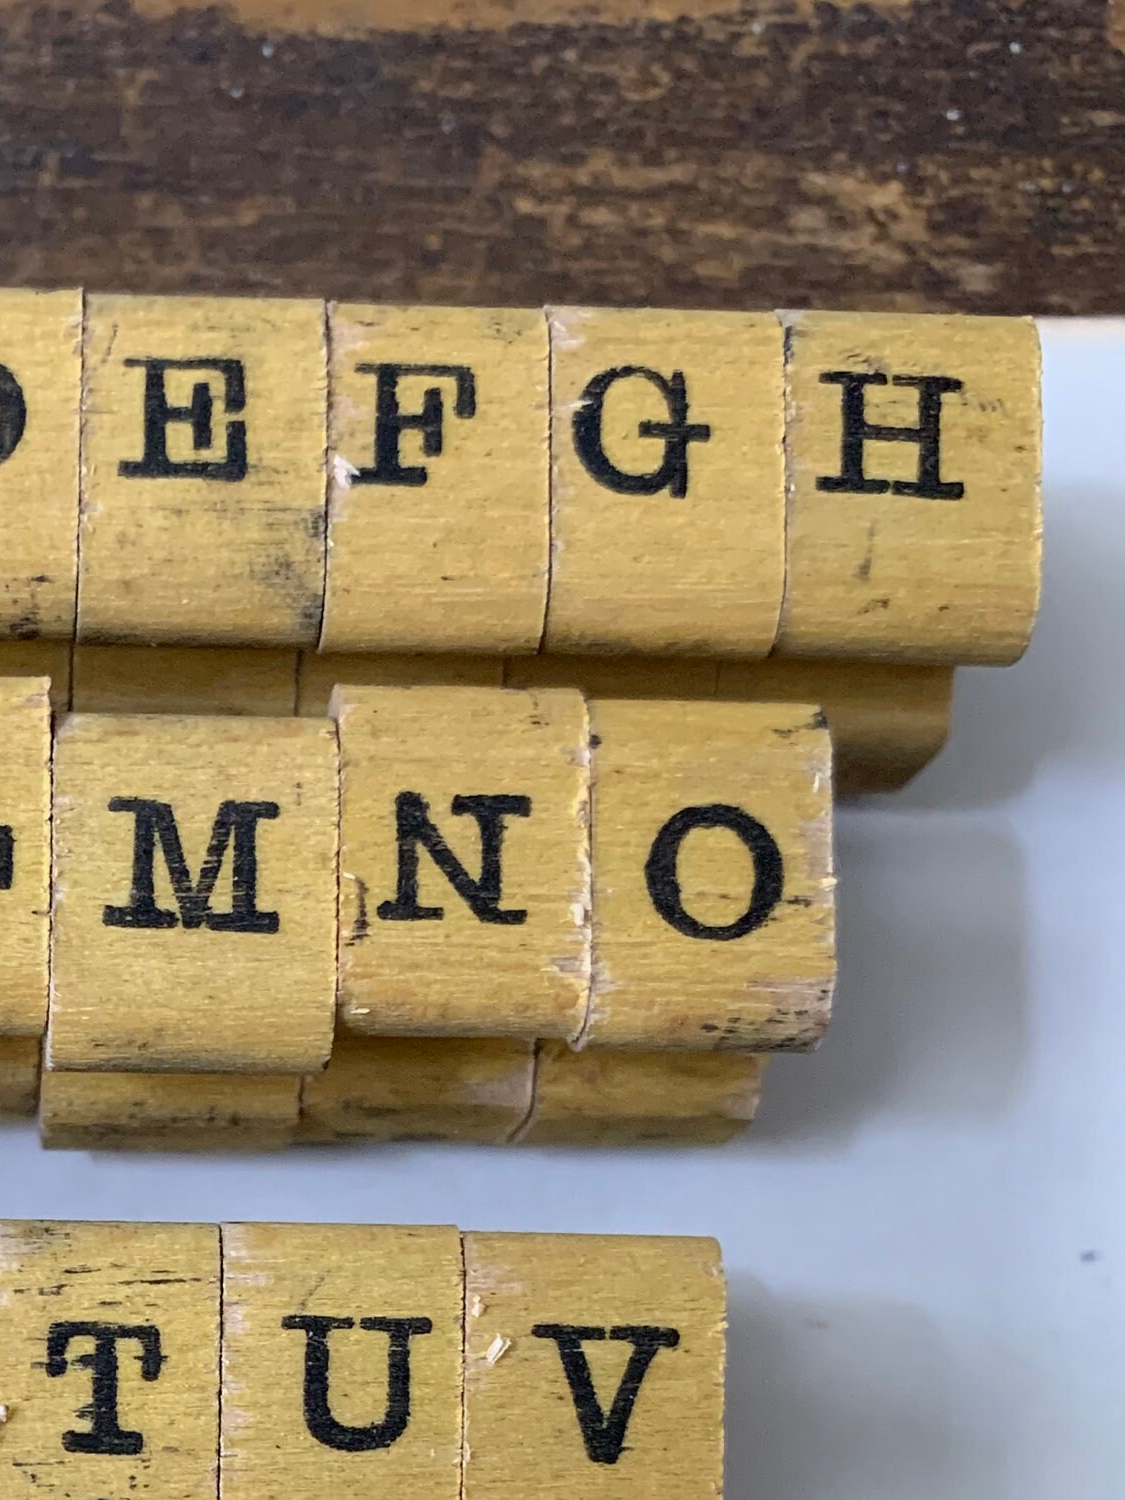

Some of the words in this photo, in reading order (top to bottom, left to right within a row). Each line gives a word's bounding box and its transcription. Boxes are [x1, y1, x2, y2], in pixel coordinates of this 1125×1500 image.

[120, 358, 248, 480] E
[359, 364, 476, 485] F
[573, 366, 711, 498] G
[817, 370, 965, 501] H
[103, 797, 279, 934] M
[377, 791, 531, 925] N
[644, 804, 784, 941] O
[42, 1321, 164, 1455] T
[282, 1315, 433, 1452] U
[531, 1324, 680, 1465] V
